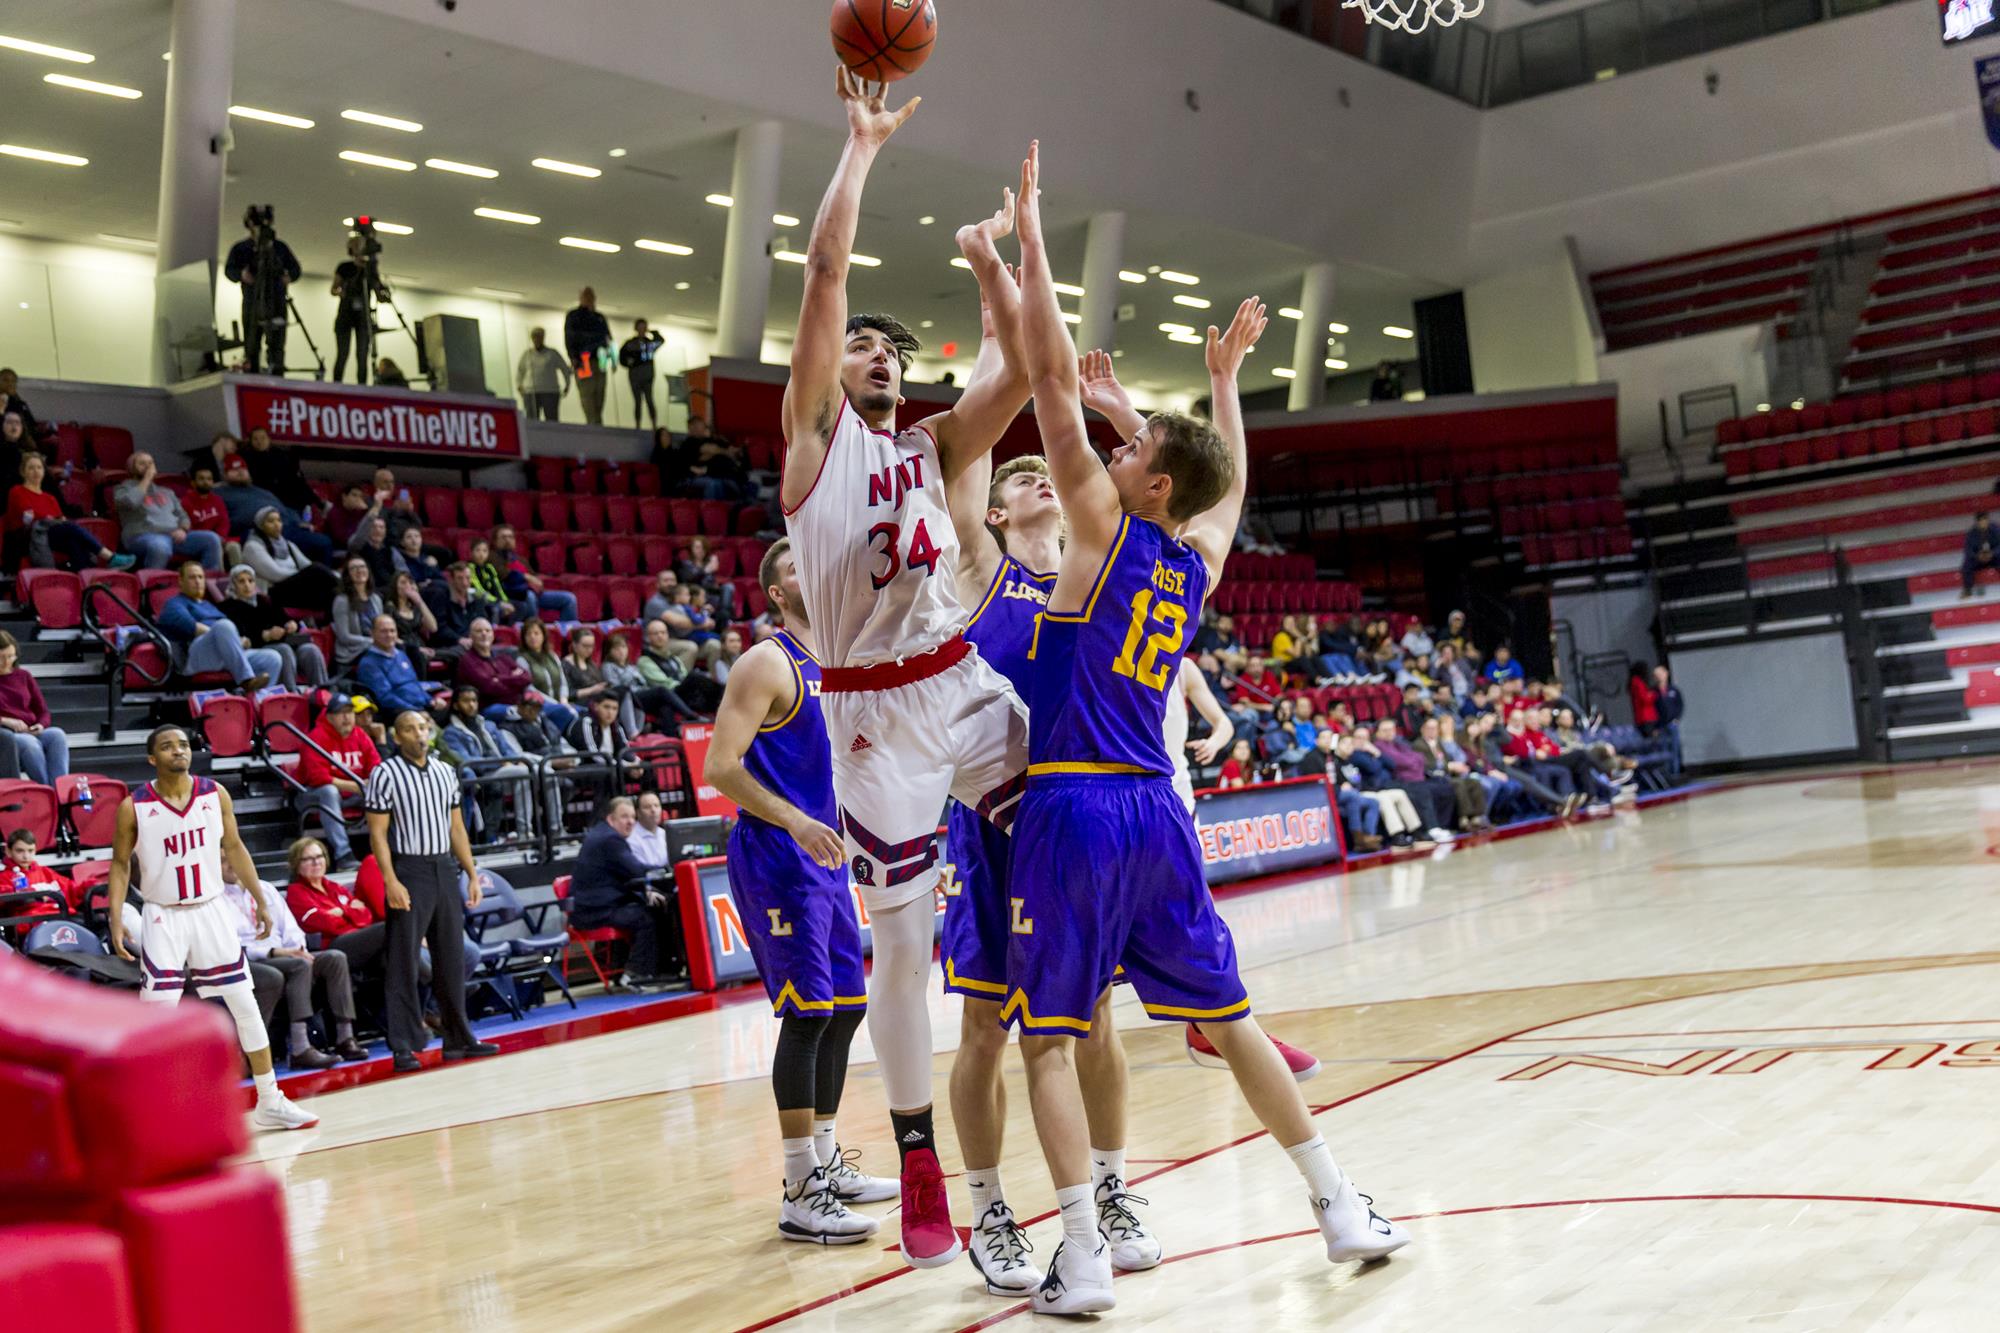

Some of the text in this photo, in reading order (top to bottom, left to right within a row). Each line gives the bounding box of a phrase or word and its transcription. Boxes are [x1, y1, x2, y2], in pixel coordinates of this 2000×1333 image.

[267, 396, 497, 450] #ProtectTheWEC
[868, 454, 924, 512] NJIT
[868, 518, 942, 591] 34
[1002, 580, 1049, 606] LIPS
[1112, 588, 1188, 692] 12
[163, 826, 206, 858] NJIT
[1199, 805, 1331, 865] ECHNOLOGY
[175, 863, 202, 900] 11
[767, 908, 792, 937] L
[1010, 897, 1033, 935] L
